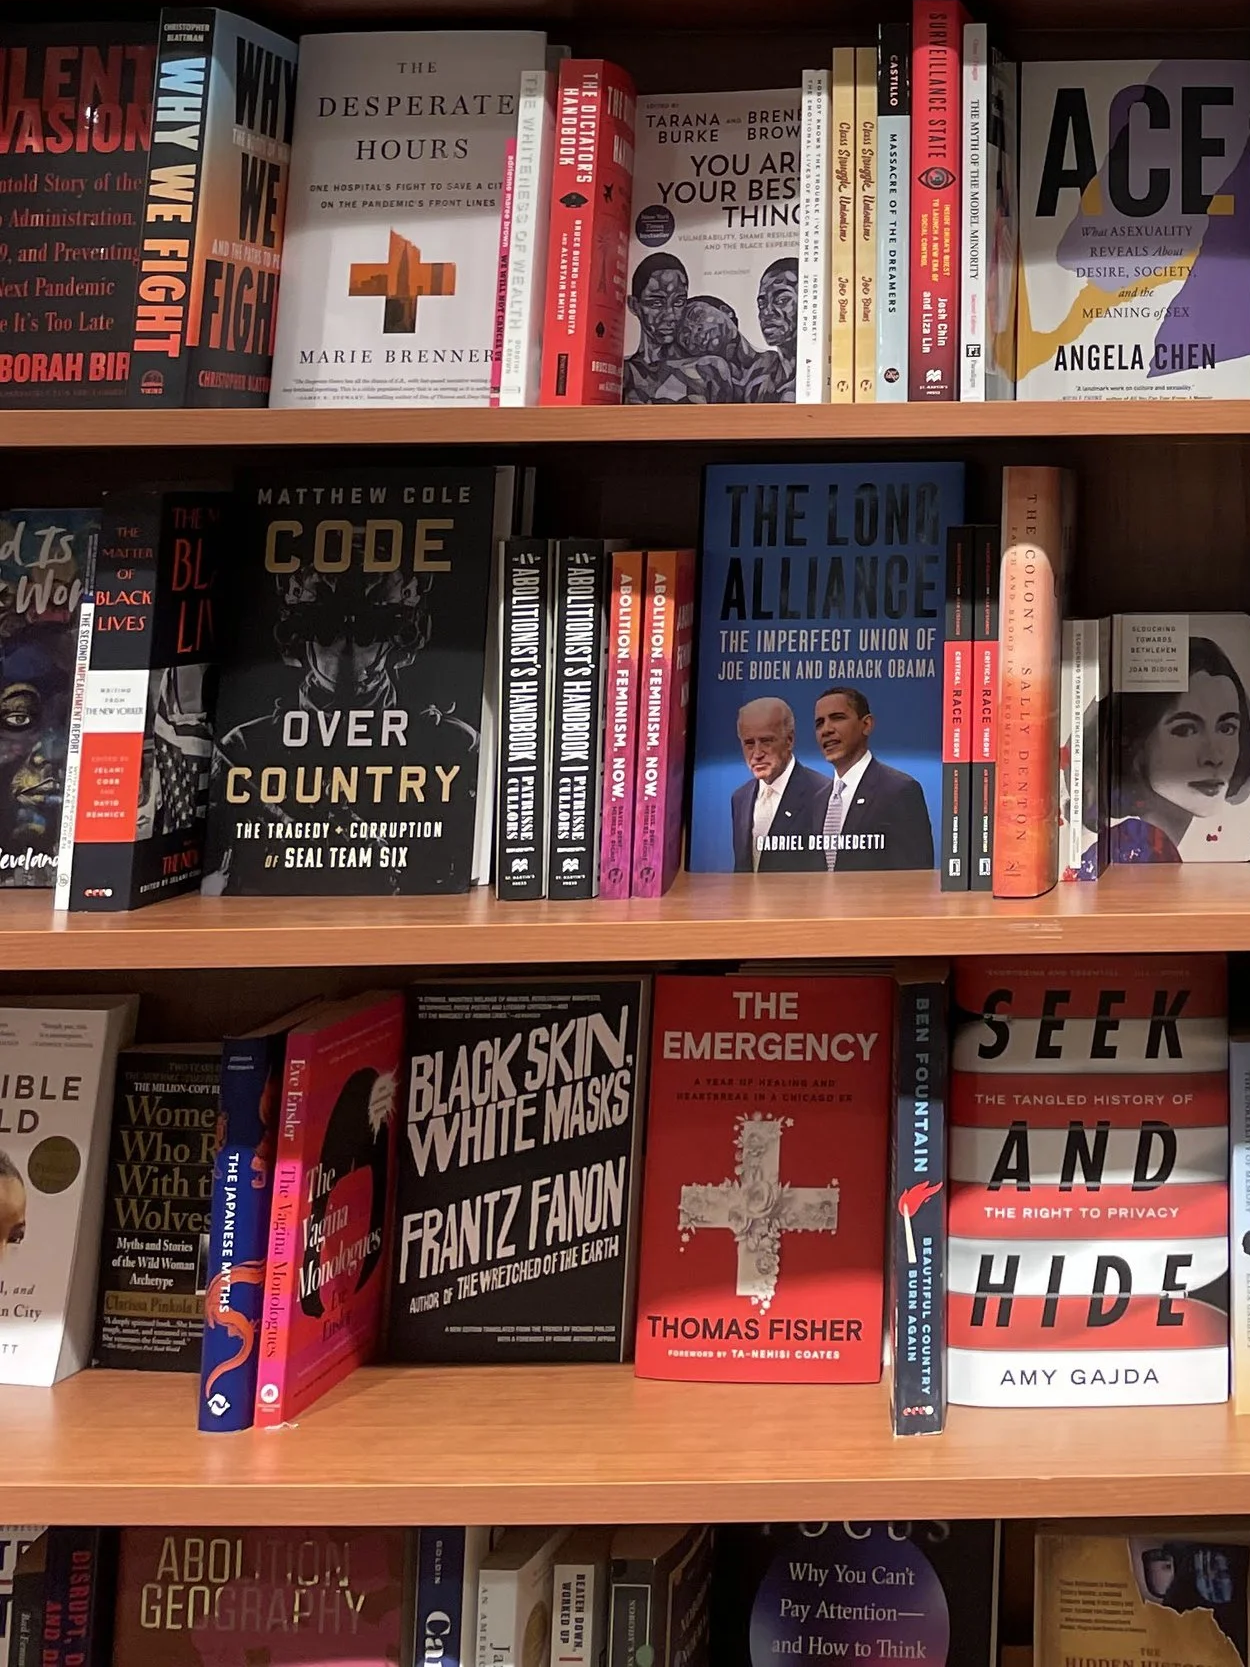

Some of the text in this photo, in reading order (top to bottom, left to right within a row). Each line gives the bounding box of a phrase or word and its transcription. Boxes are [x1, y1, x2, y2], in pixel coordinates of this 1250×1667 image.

[397, 62, 437, 74] THE
[318, 94, 515, 118] DESPERATE
[355, 139, 469, 161] HOURS
[1035, 85, 1234, 217] ACE
[133, 57, 207, 358] WHY WE FIGHT
[888, 134, 897, 313] MASSACRE OF THE DREAMERS
[1054, 343, 1216, 371] ANGELA CHEN
[258, 486, 471, 505] MATTHEW COLE
[264, 519, 454, 573] CODE
[719, 628, 936, 653] THE IMPERFECT UNION OF
[718, 658, 935, 681] JOE BIDEN AND BARACK OBAMA
[282, 710, 408, 747] OVER
[226, 765, 460, 805] COUNTRY
[267, 822, 442, 839] TRAGEDY CORRUPTION
[757, 835, 885, 852] GABRIEL DEBENEDETTI
[284, 847, 407, 869] SEAL TEAM SIX
[732, 990, 800, 1021] THE
[976, 989, 1194, 1060] SEEK
[662, 1032, 879, 1063] EMERGENCY
[407, 1004, 634, 1123] BLACK SKIN,
[406, 1068, 631, 1178] WHITE MASKS
[987, 1120, 1181, 1192] AND
[399, 1156, 626, 1284] FRANTZ FANON
[984, 1205, 1180, 1220] THE RIGHT TO PRIVACY
[969, 1253, 1195, 1329] HIDE
[646, 1315, 862, 1343] THOMAS FISHER
[1000, 1366, 1161, 1389] AMY GAJDA
[789, 1563, 915, 1587] Why You Can't
